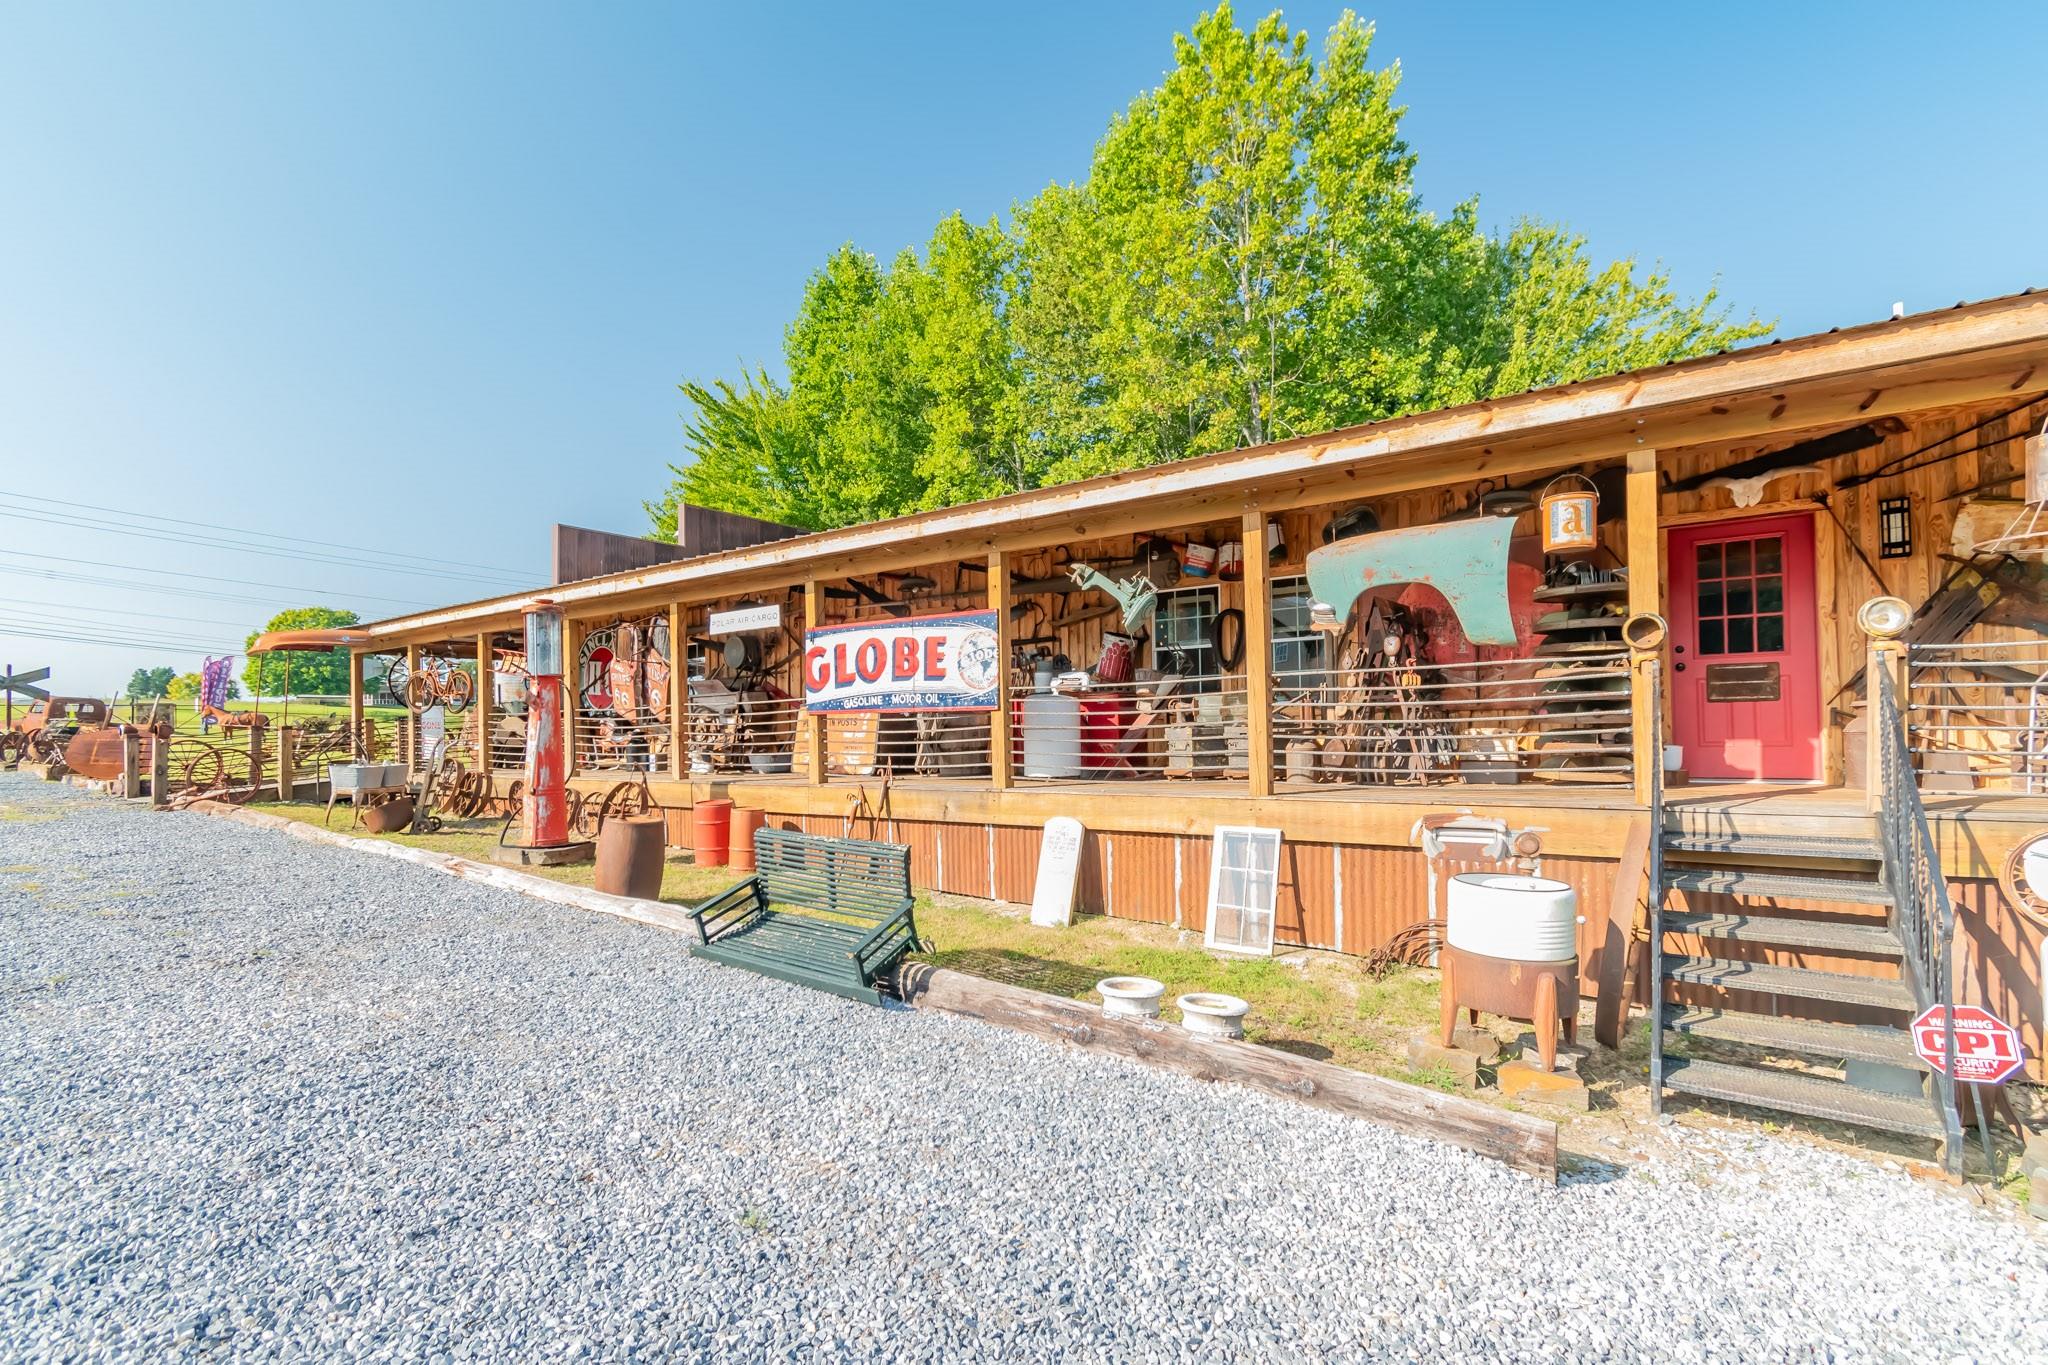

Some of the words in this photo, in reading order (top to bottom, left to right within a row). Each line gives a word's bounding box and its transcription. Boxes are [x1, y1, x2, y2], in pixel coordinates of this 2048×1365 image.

[737, 616, 749, 625] AIR
[751, 612, 778, 623] CARGO
[806, 635, 948, 693] GLOBE
[843, 695, 883, 709] GASOLINE
[891, 694, 922, 705] MOTOR
[925, 693, 940, 704] OIL
[1921, 1029, 2012, 1057] CPI
[1938, 1056, 2000, 1069] SCURITY
